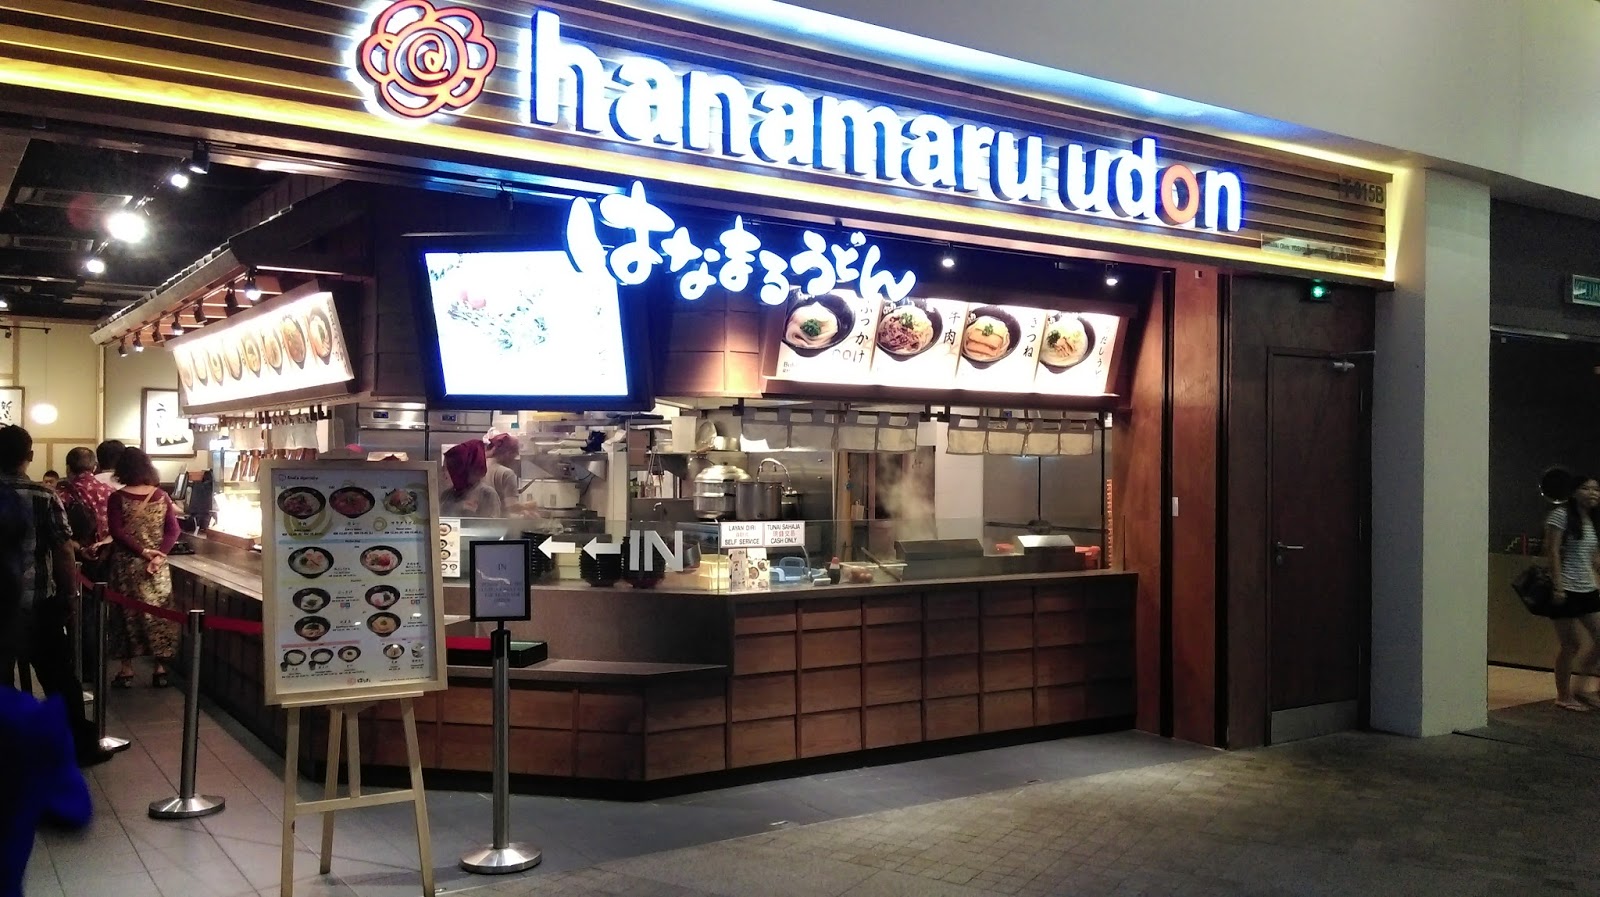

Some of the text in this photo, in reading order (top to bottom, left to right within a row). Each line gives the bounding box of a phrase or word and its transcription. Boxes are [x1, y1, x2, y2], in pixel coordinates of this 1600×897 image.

[524, 8, 1244, 233] hanamaru udon
[564, 180, 917, 305] はなまるうどん
[629, 529, 684, 572] IN
